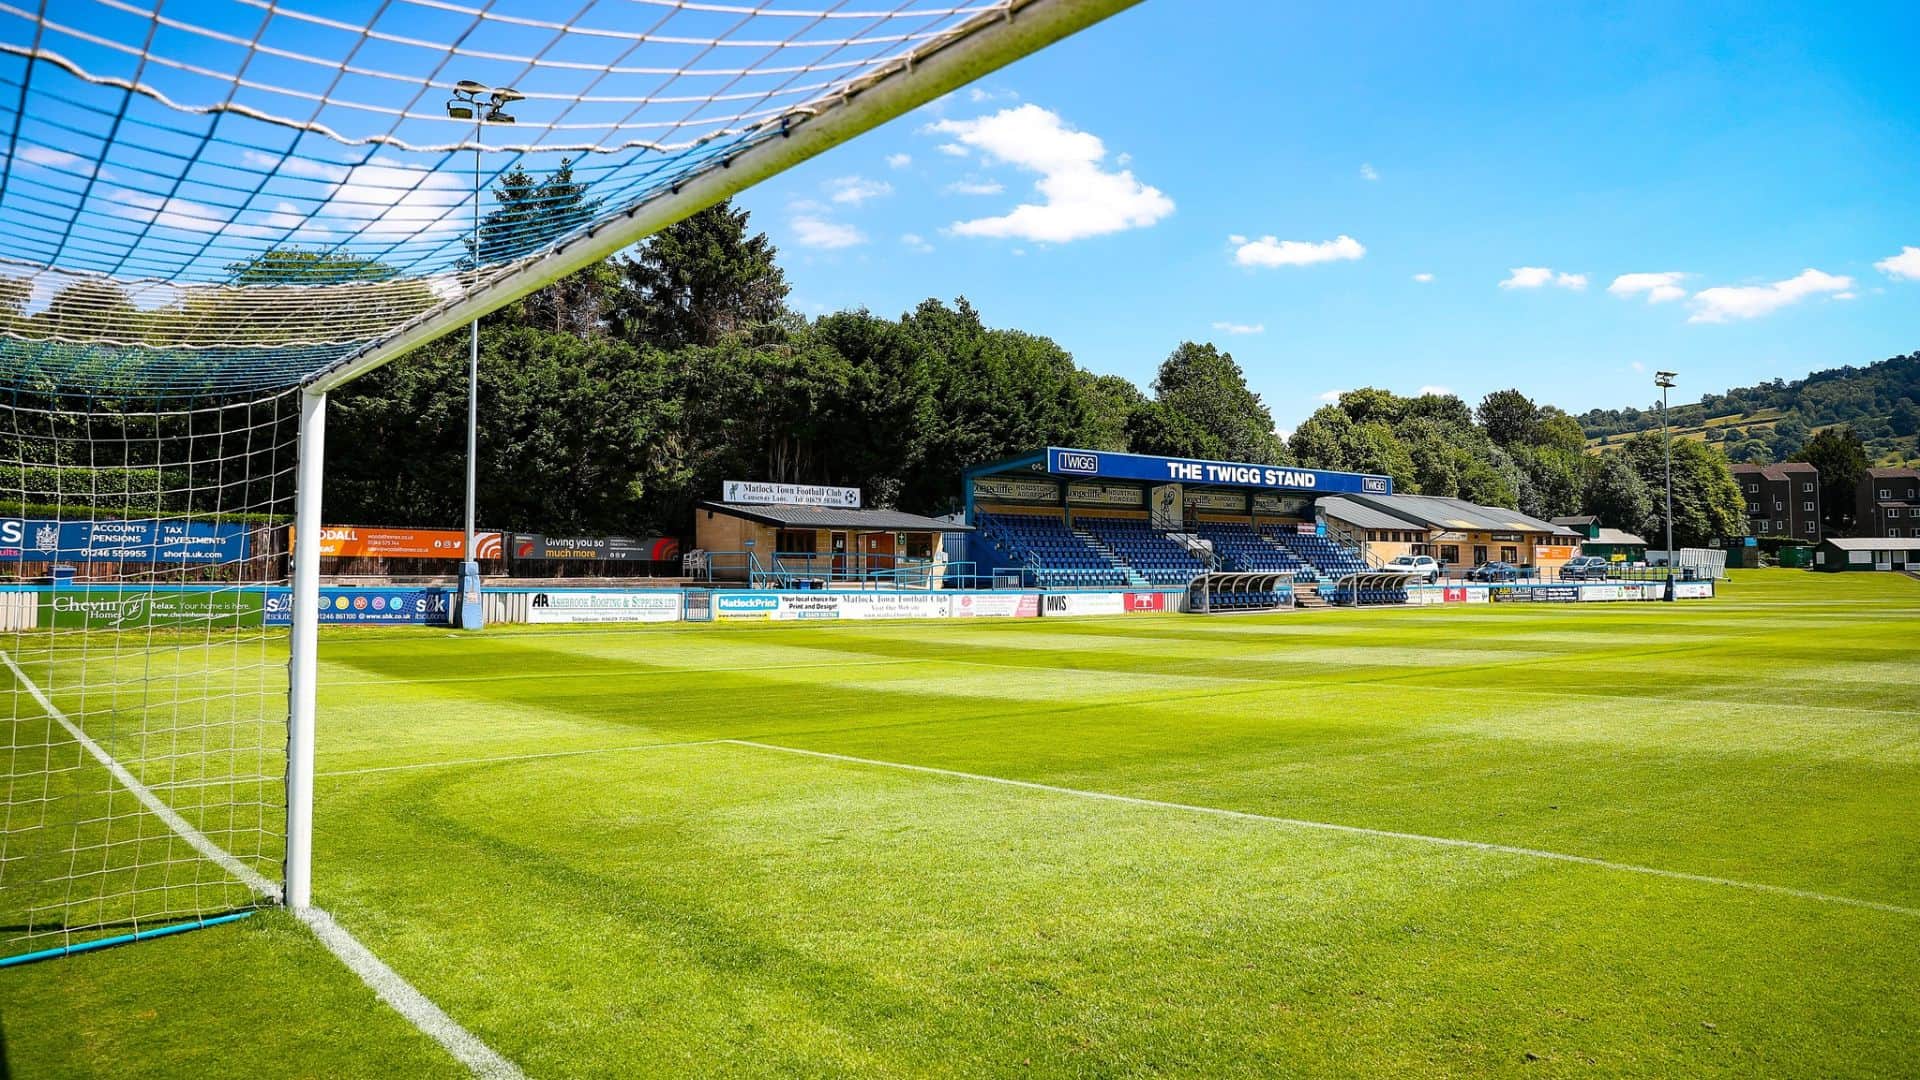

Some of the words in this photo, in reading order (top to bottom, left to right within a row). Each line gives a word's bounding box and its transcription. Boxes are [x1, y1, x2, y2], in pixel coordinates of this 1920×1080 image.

[1064, 453, 1095, 470] TWIGG
[1167, 462, 1202, 480] THE
[1205, 465, 1261, 484] TWIGG
[1264, 469, 1316, 488] STAND
[743, 483, 773, 493] Matlock
[776, 484, 794, 494] Town
[796, 485, 825, 496] Football
[826, 487, 842, 497] Club
[93, 524, 147, 533] ACCOUNTS
[164, 526, 182, 534] TAX
[92, 534, 142, 543] PENSIONS
[163, 535, 226, 544] INVESTMENTS
[575, 539, 593, 549] you
[112, 550, 147, 558] 559955
[163, 551, 222, 559] shorts.uk.com
[545, 548, 572, 558] much
[573, 550, 597, 558] more
[532, 593, 549, 608] AR
[720, 598, 777, 608] MatlockPrint
[810, 595, 828, 603] choice
[1047, 595, 1067, 611] MVIS
[54, 597, 118, 612] Chevin
[151, 602, 177, 610] Relax.
[178, 602, 199, 610] Your
[199, 602, 223, 610] home
[224, 602, 231, 610] is
